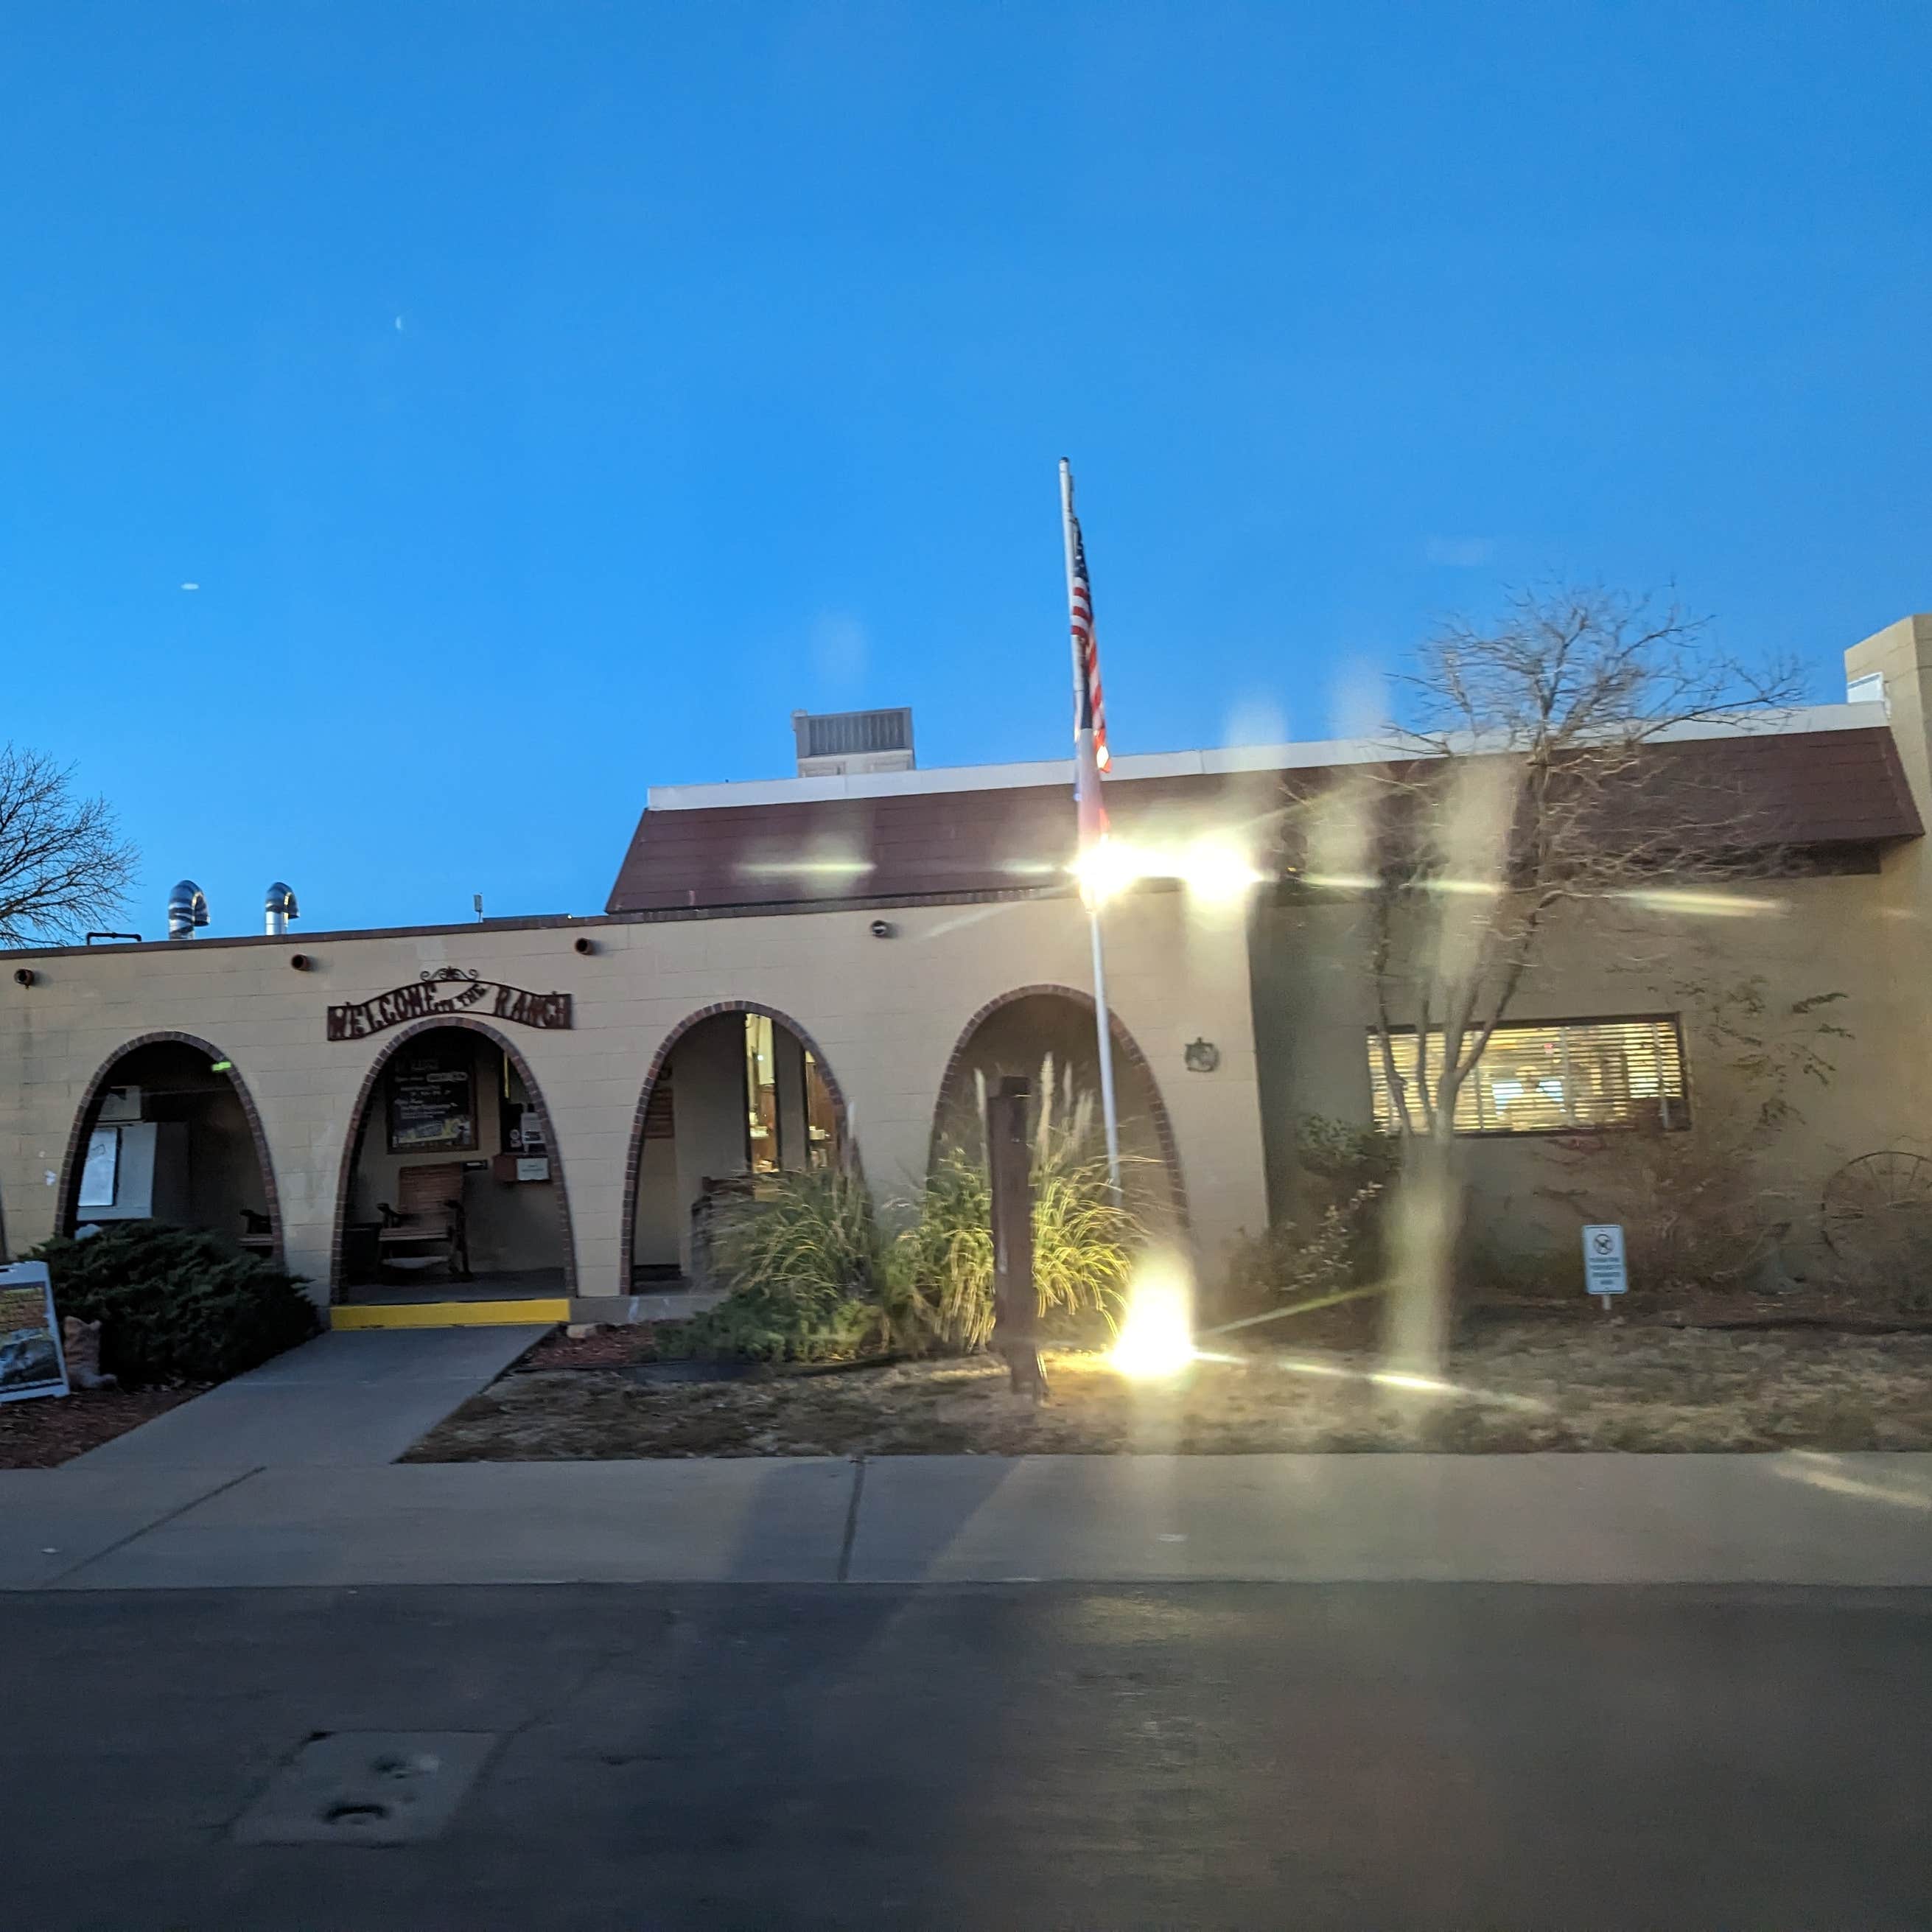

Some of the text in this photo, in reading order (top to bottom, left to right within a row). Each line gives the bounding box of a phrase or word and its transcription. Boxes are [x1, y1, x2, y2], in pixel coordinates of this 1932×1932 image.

[327, 981, 438, 1040] WELCOME
[456, 983, 486, 1007] THE
[493, 986, 572, 1029] RANCH
